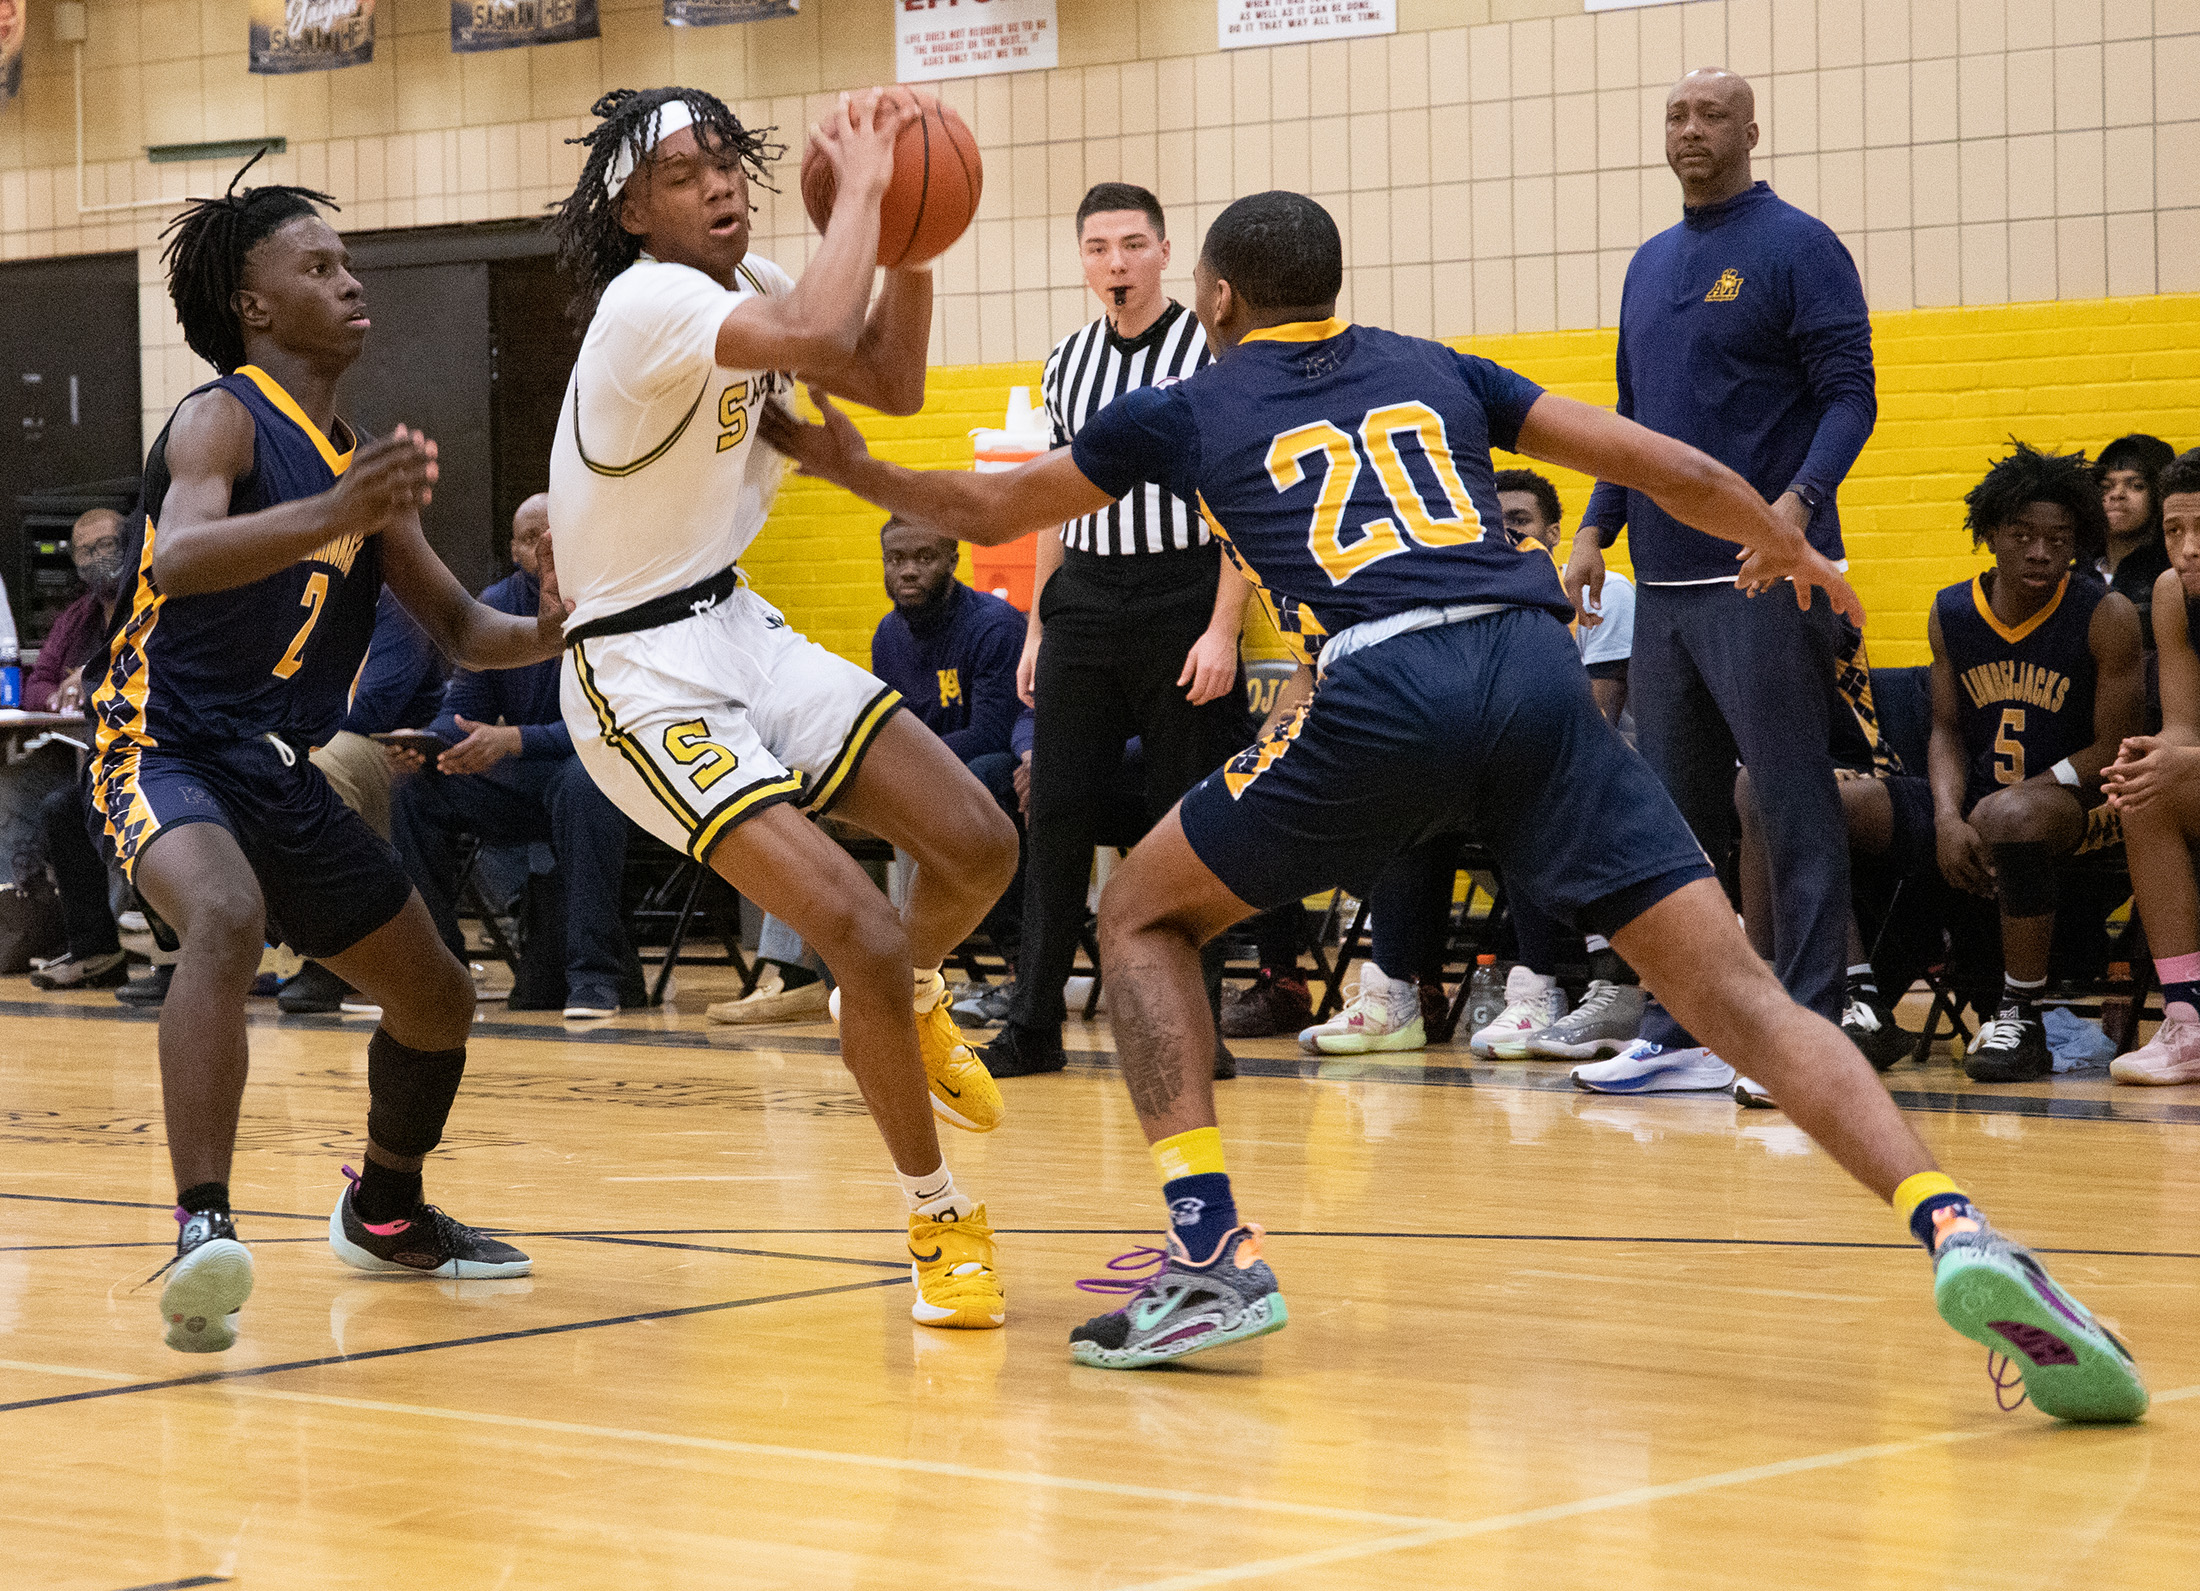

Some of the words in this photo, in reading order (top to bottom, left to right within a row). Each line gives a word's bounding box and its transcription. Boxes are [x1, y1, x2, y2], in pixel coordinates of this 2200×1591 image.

[1255, 10, 1277, 19] WELL
[1309, 5, 1327, 15] CAN
[1259, 21, 1282, 31] THAT
[1287, 19, 1308, 28] WAY
[1313, 16, 1329, 26] ALL
[1264, 400, 1487, 587] 20
[272, 572, 329, 679] 2
[1960, 660, 2070, 713] LUMBERJACKS
[662, 717, 738, 795] S
[1994, 708, 2025, 785] 5
